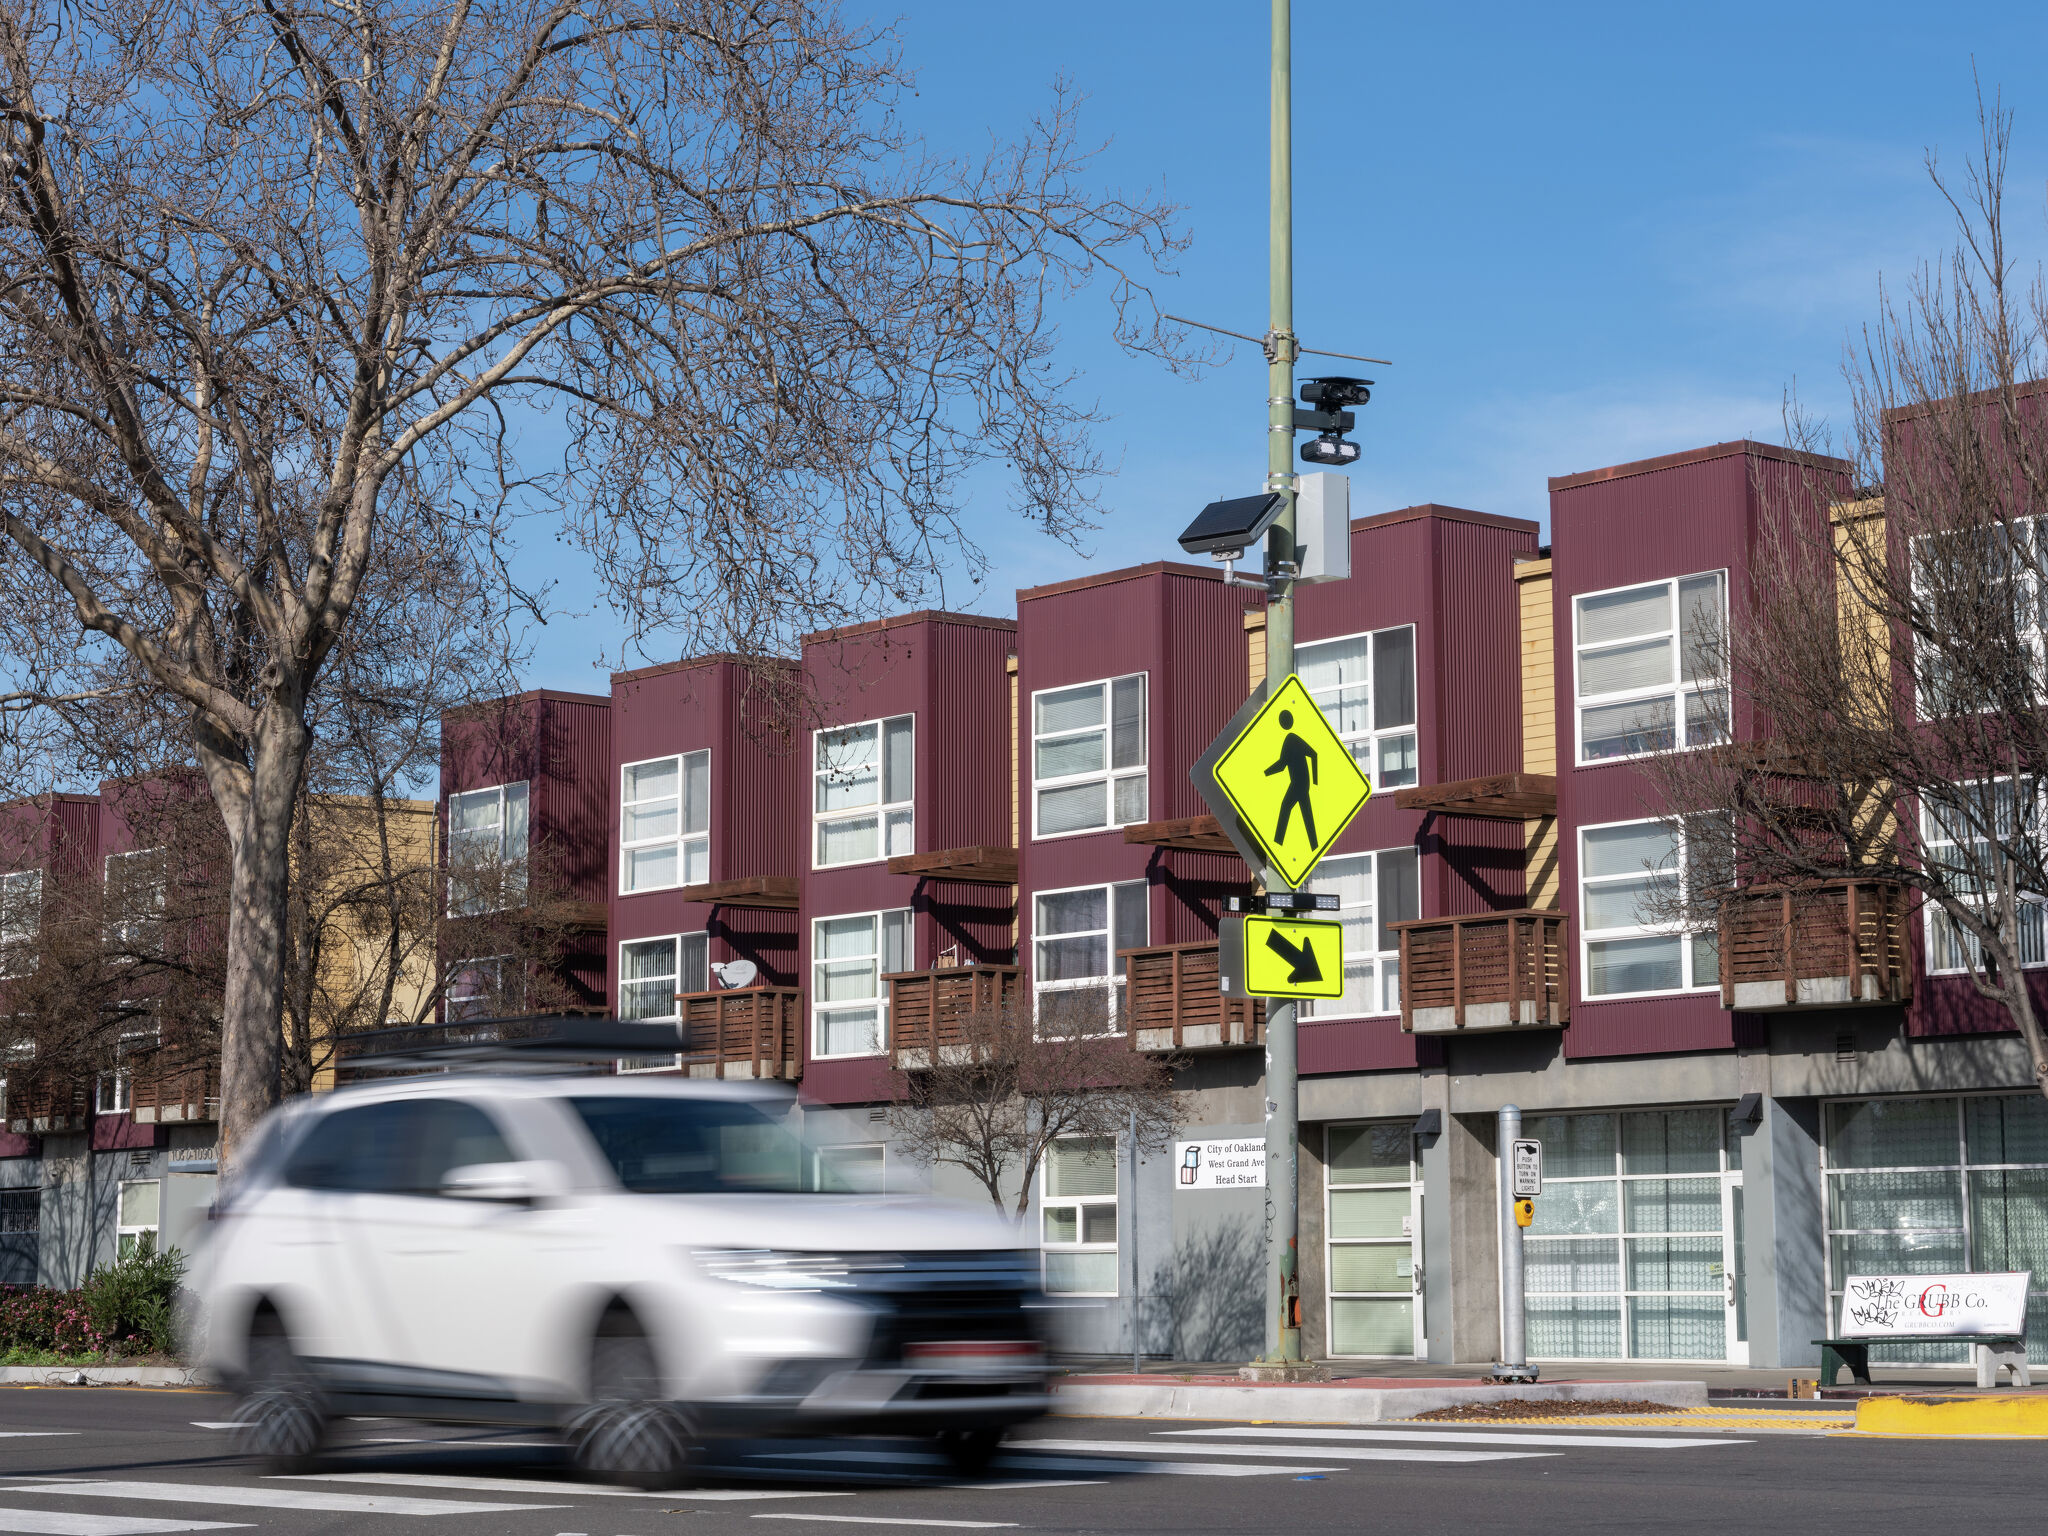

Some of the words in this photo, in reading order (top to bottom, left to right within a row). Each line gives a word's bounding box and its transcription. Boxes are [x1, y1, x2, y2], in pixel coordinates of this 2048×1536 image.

[1207, 1144, 1223, 1155] City
[1224, 1144, 1232, 1153] of
[1234, 1143, 1266, 1152] Oakland
[1208, 1160, 1225, 1168] West
[1227, 1159, 1249, 1168] Grand
[1251, 1158, 1265, 1167] Ave
[1215, 1175, 1236, 1184] Head
[1238, 1174, 1258, 1184] Start
[1876, 1293, 1900, 1309] The
[1904, 1293, 1960, 1309] GRUBB
[1965, 1292, 1988, 1308] Co.
[1904, 1321, 1955, 1329] GRUBBCO.COM
